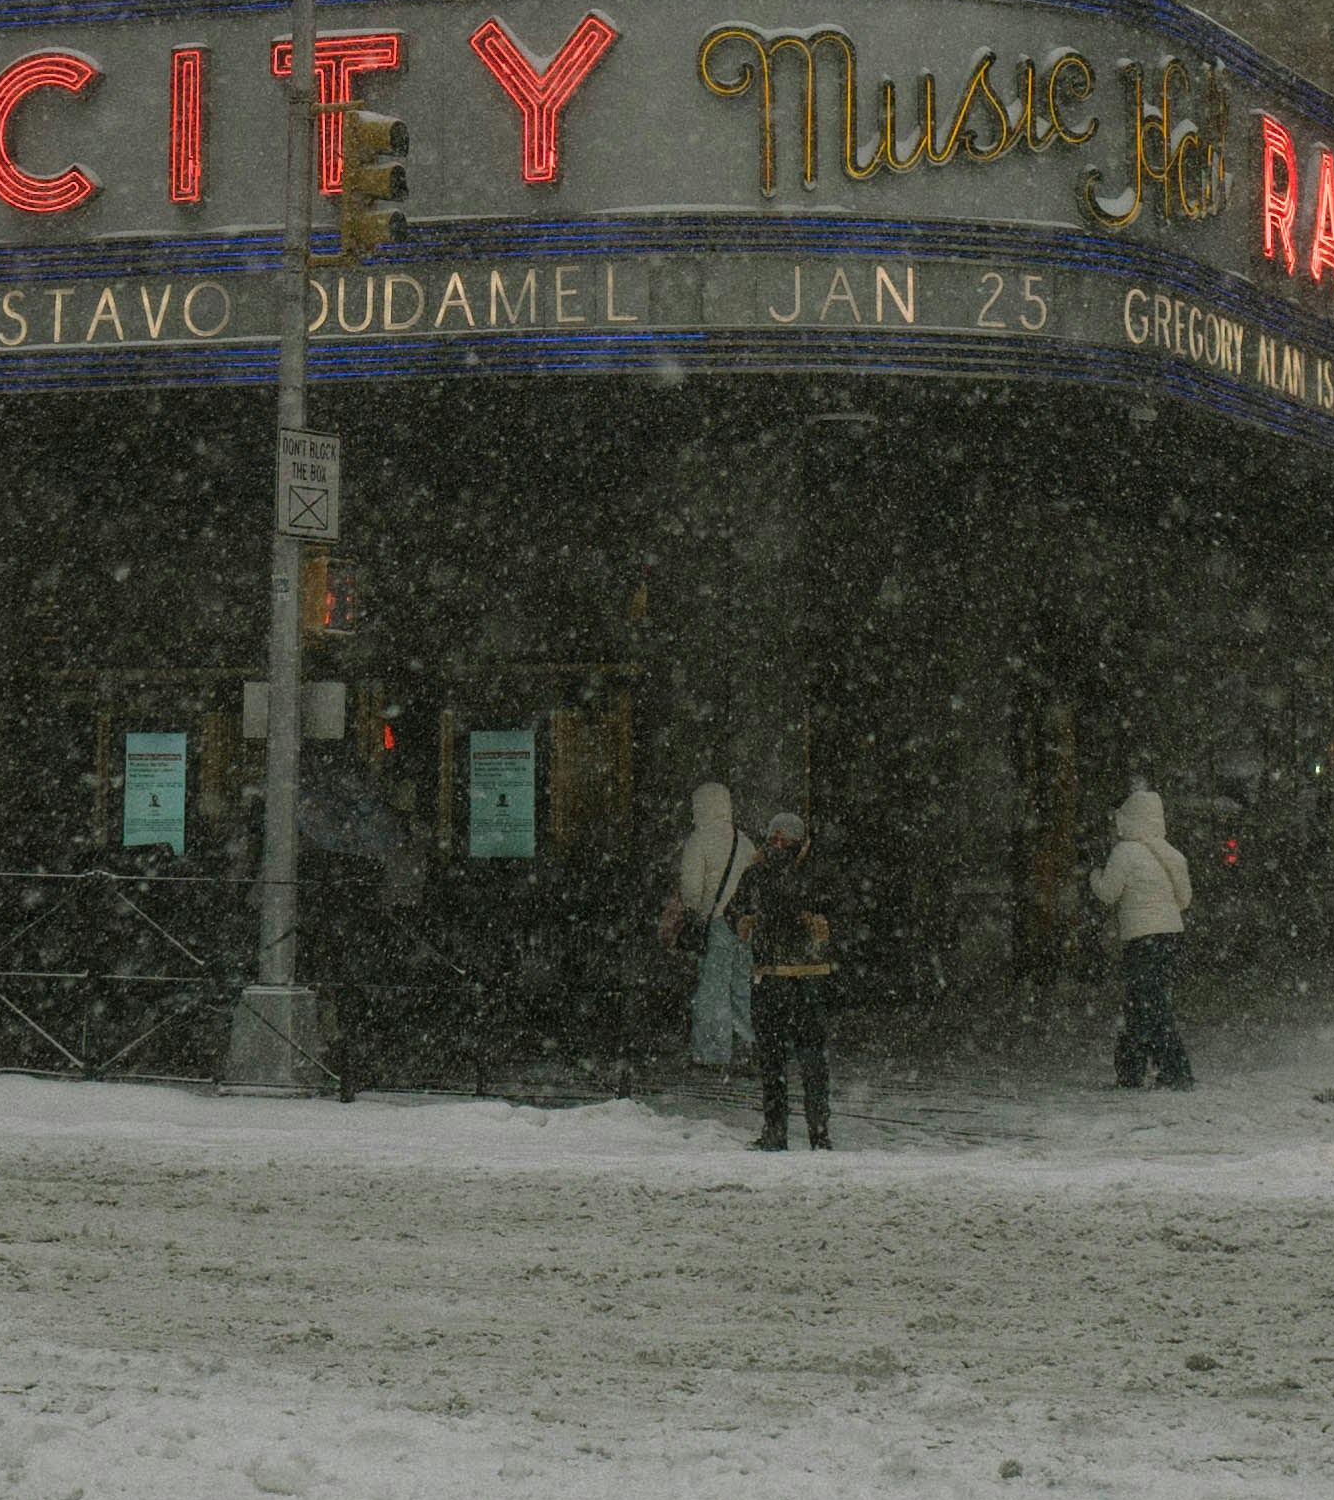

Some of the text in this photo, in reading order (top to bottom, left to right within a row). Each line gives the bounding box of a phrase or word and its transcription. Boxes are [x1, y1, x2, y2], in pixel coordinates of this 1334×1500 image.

[698, 23, 1099, 198] Music
[769, 265, 915, 326] JAN
[978, 272, 1048, 330] 25
[1123, 287, 1244, 376] GREGORY
[1256, 333, 1306, 400] ALAN
[292, 461, 327, 484] THE BOX
[309, 440, 337, 461] BLOCK
